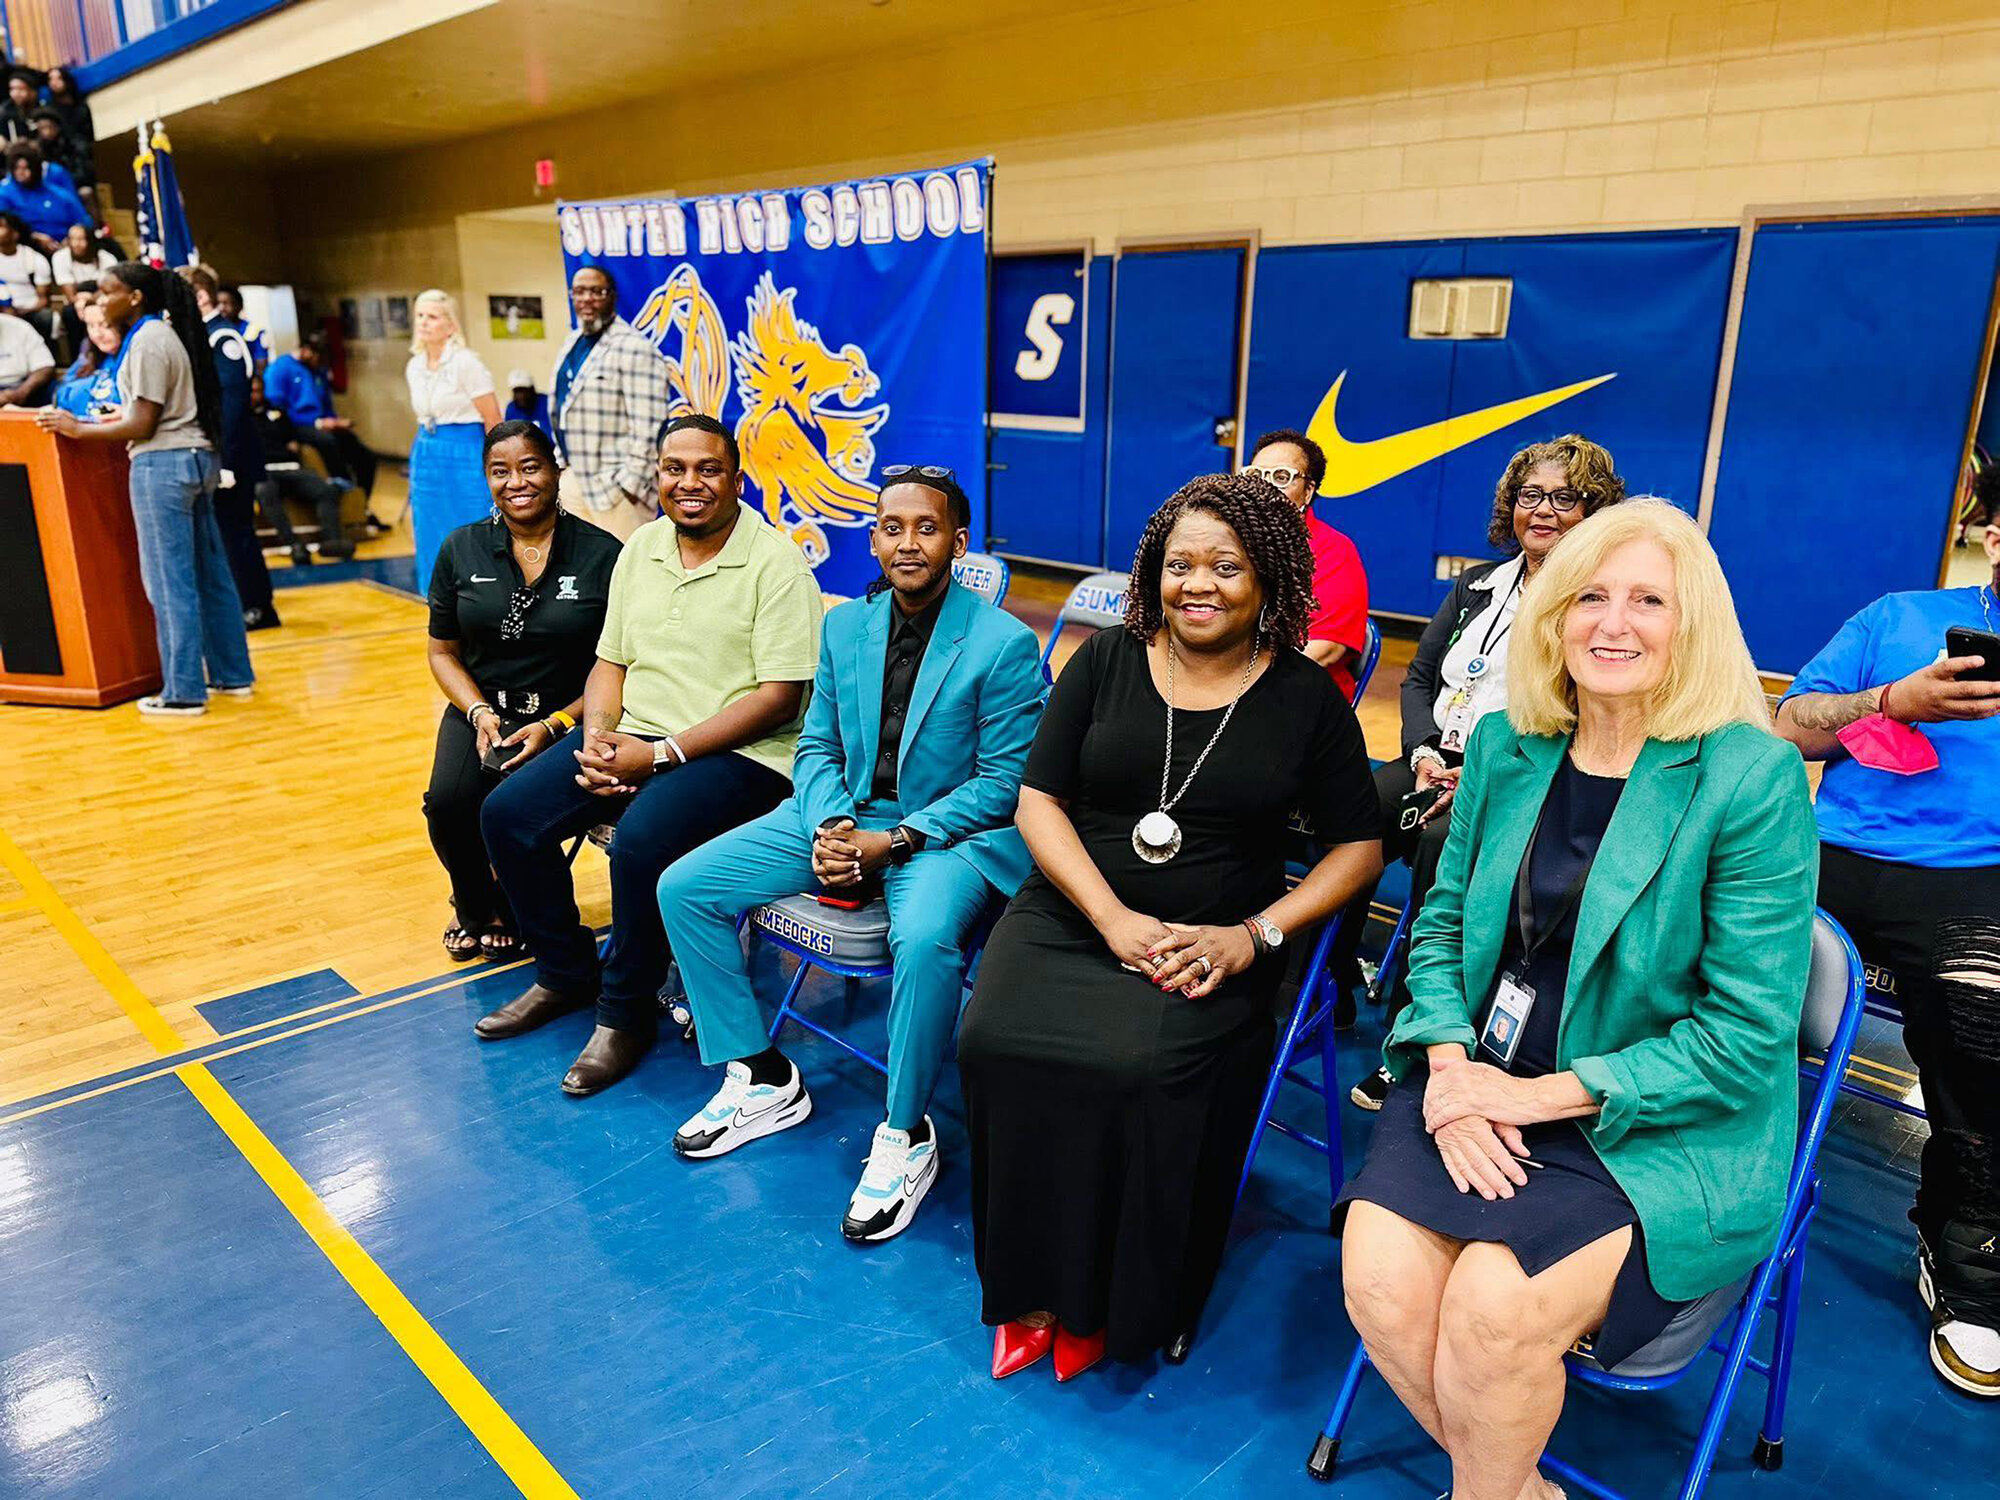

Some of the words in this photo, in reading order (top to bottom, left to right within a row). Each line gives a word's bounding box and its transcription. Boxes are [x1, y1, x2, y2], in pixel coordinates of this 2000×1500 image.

[560, 203, 687, 257] SUMTER
[695, 194, 791, 256] HIGH
[801, 166, 984, 250] SCHOOL
[1015, 293, 1075, 381] S
[952, 562, 994, 592] MTER
[754, 906, 834, 956] AMECOCKS
